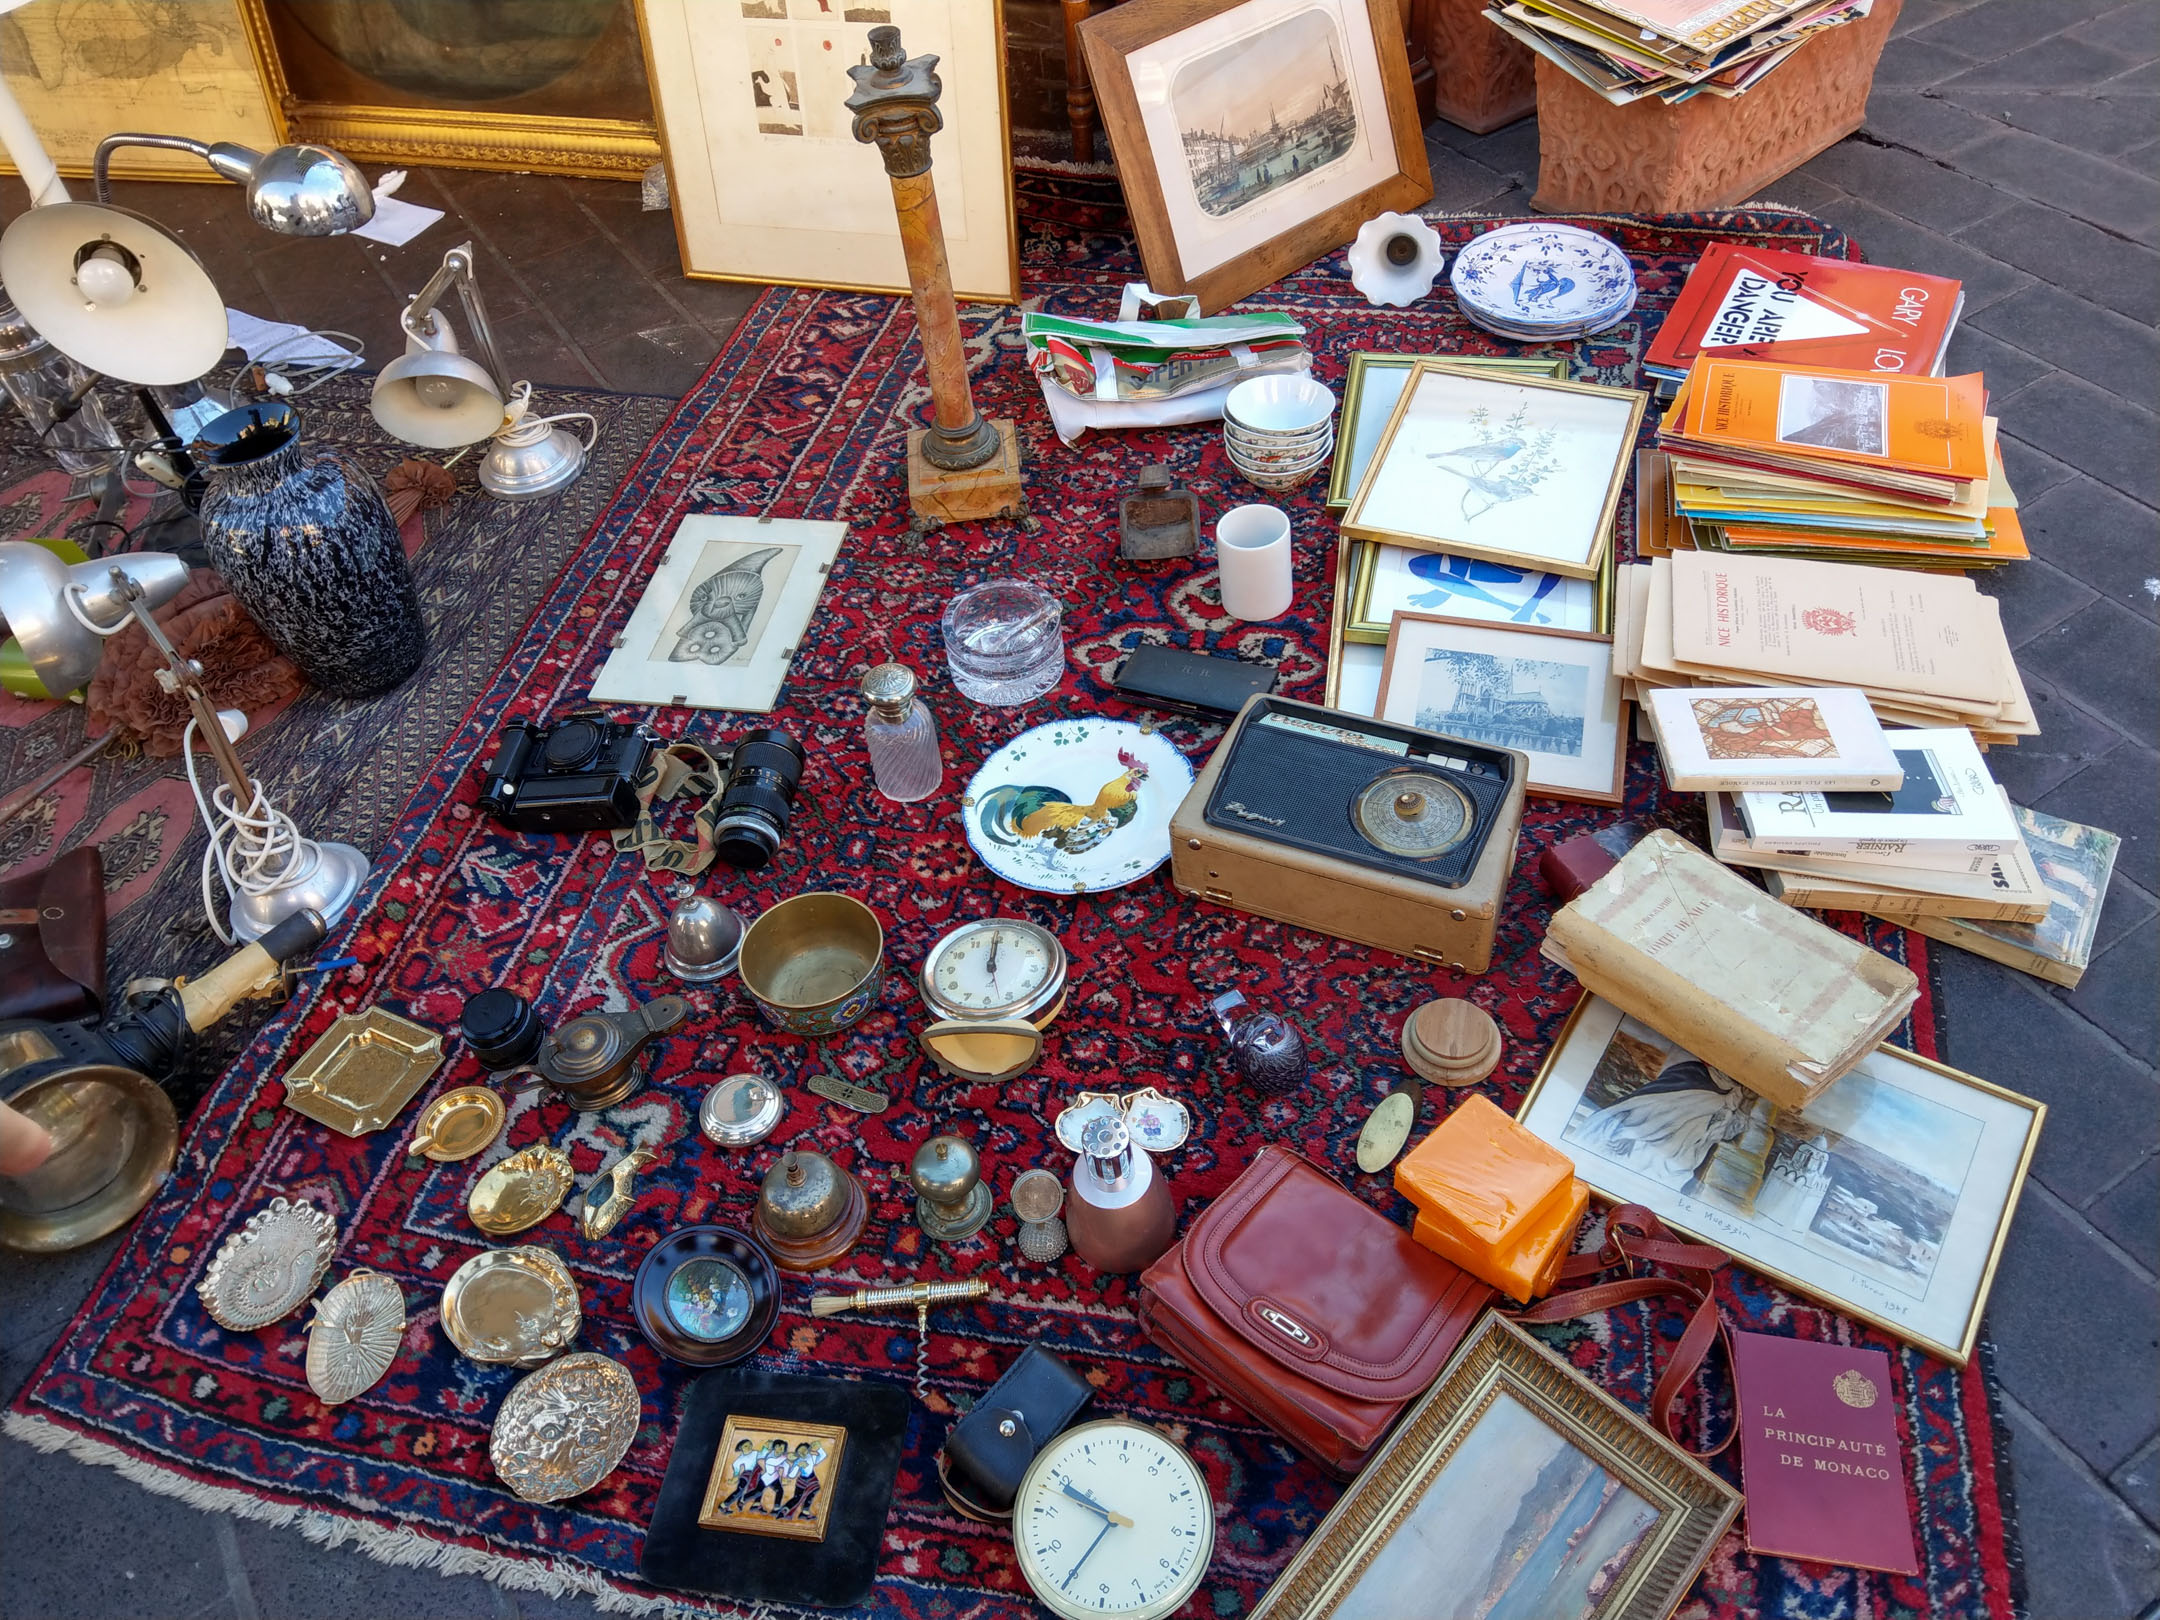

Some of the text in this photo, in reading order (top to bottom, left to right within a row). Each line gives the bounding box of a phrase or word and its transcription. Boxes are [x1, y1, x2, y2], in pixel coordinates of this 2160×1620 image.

[1711, 277, 1768, 344] DANGER
[1748, 271, 1808, 344] YOU ARE
[1891, 287, 1929, 327] GARY
[1716, 572, 1731, 647] NICE HISTORIQUE
[1812, 803, 1824, 814] Un
[1856, 842, 1905, 853] RAINIER
[952, 951, 965, 960] 10
[948, 981, 958, 990] 8
[1021, 980, 1031, 989] 4
[963, 992, 972, 1001] 7
[1763, 1405, 1786, 1419] LA
[1764, 1427, 1887, 1457] PRINCIPAUTÉ
[1118, 1453, 1130, 1464] 2
[1147, 1465, 1159, 1477] 3
[1780, 1454, 1890, 1480] DE MONACO
[1058, 1474, 1073, 1488] 12
[1168, 1493, 1178, 1503] 4
[1045, 1505, 1059, 1519] 11
[1170, 1525, 1182, 1537] 5
[1047, 1539, 1062, 1553] 10
[1159, 1558, 1170, 1568] 6
[1099, 1583, 1110, 1594] 8
[1131, 1578, 1144, 1590] 7
